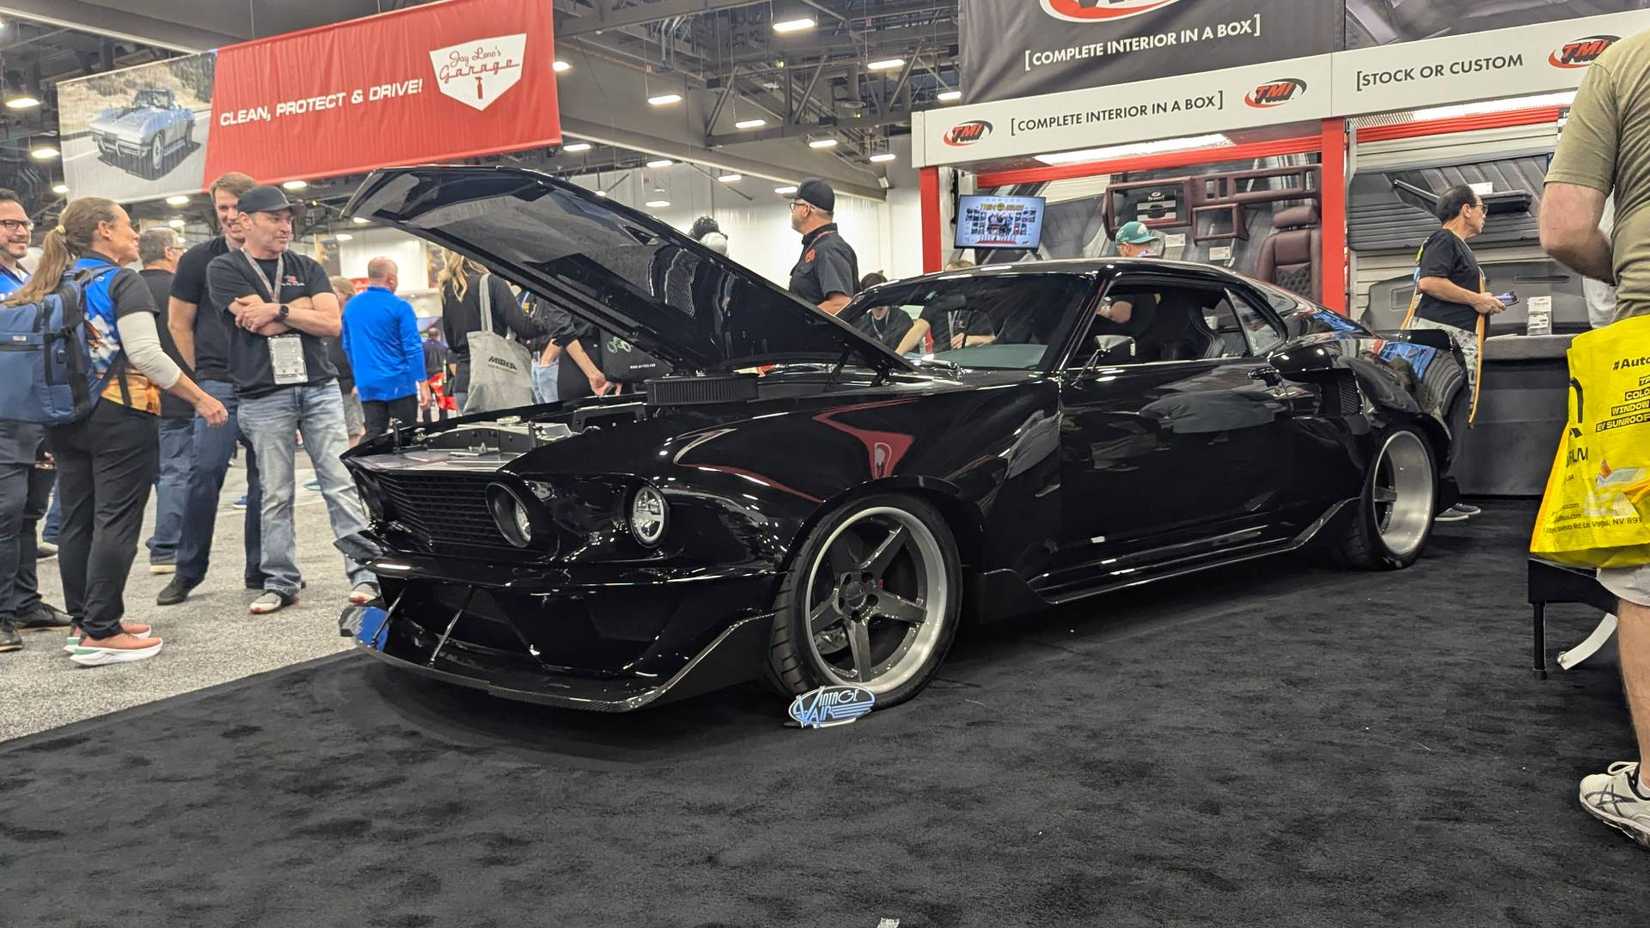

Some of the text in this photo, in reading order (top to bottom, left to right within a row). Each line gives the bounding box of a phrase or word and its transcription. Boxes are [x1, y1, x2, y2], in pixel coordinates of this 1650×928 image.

[1107, 33, 1177, 55] INTERIOR
[1181, 28, 1198, 43] IN
[1201, 26, 1214, 40] A
[440, 59, 520, 84] Garage
[1420, 62, 1445, 79] OR
[1449, 53, 1524, 76] CUSTOM
[220, 78, 424, 126] CLEAN, PROTECT & DRIVE!
[1255, 82, 1297, 104] TMI
[1086, 104, 1148, 123] INTERIOR
[1152, 101, 1168, 114] IN
[1171, 100, 1182, 112] A
